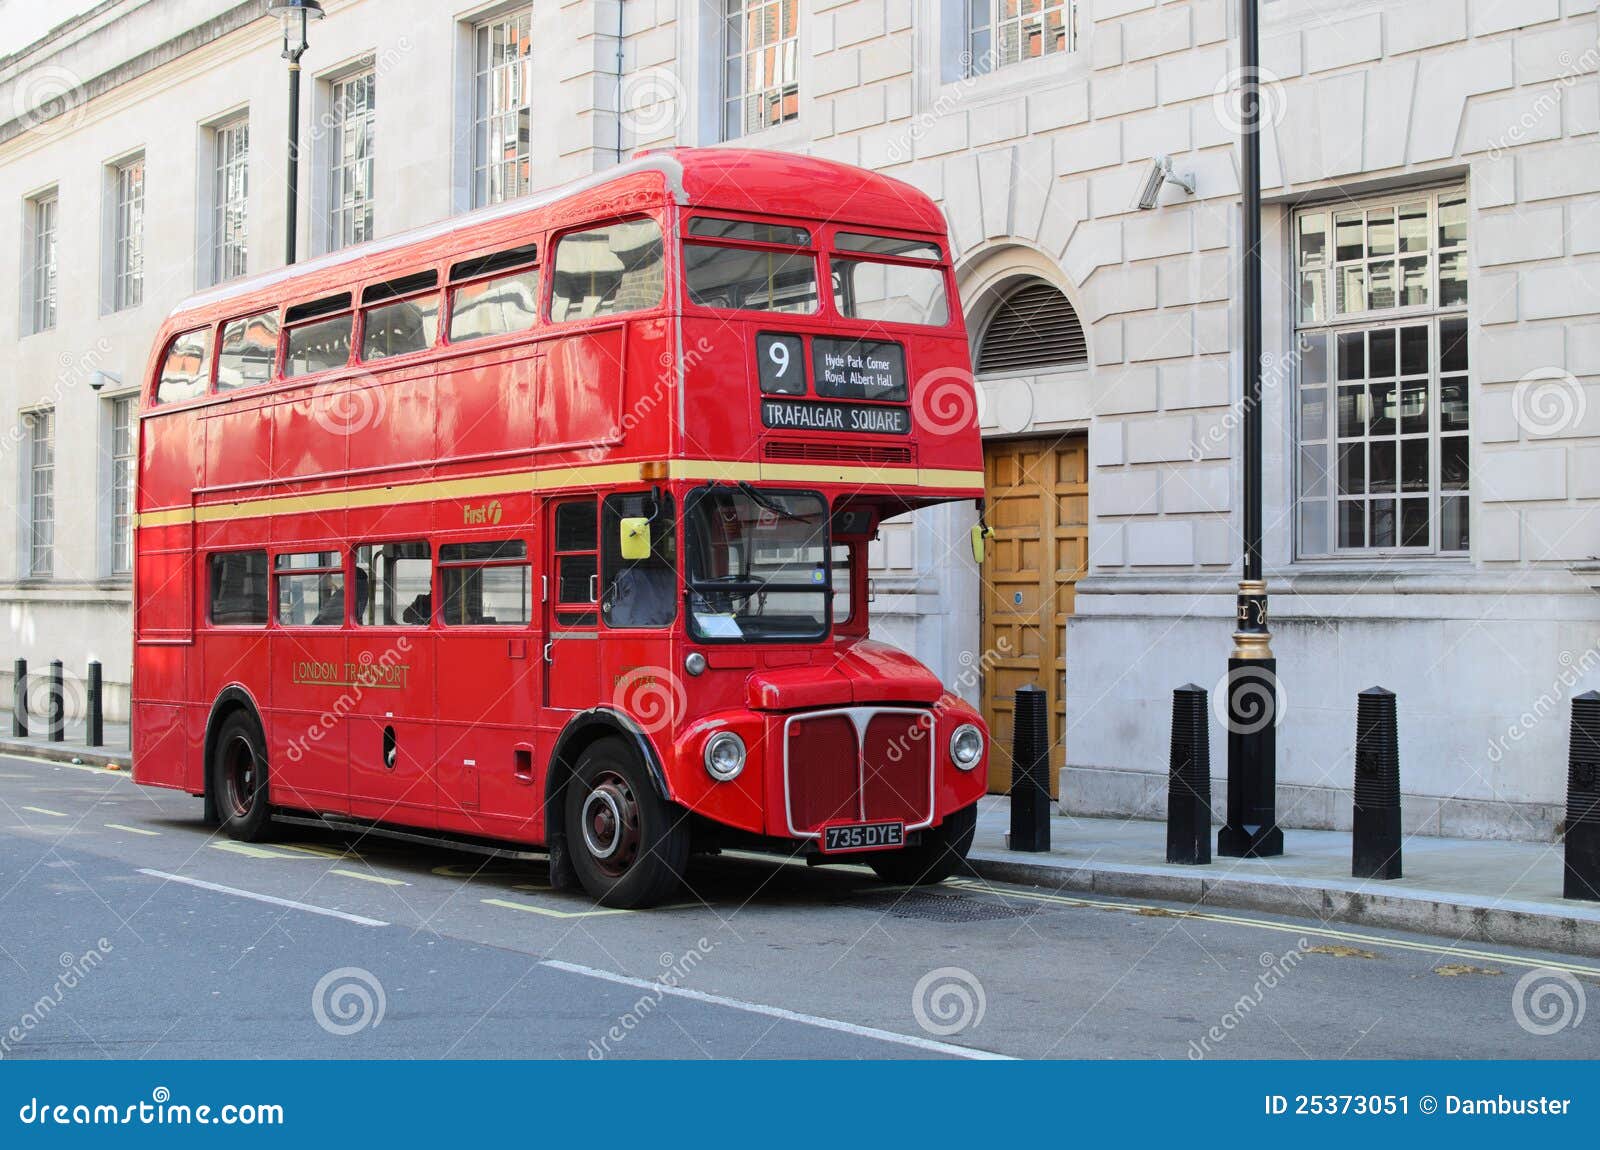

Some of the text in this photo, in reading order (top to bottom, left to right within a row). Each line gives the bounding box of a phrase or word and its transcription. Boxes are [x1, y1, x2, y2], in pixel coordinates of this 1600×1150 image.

[769, 342, 790, 378] 9
[825, 353, 890, 371] Hyde Park Corner
[825, 370, 893, 387] Royal Albert Hall
[766, 404, 902, 431] TRAFALGAR SQUARE
[464, 504, 486, 525] First
[293, 661, 410, 688] LONDON TRANSPORT
[829, 825, 899, 848] 735 DYE
